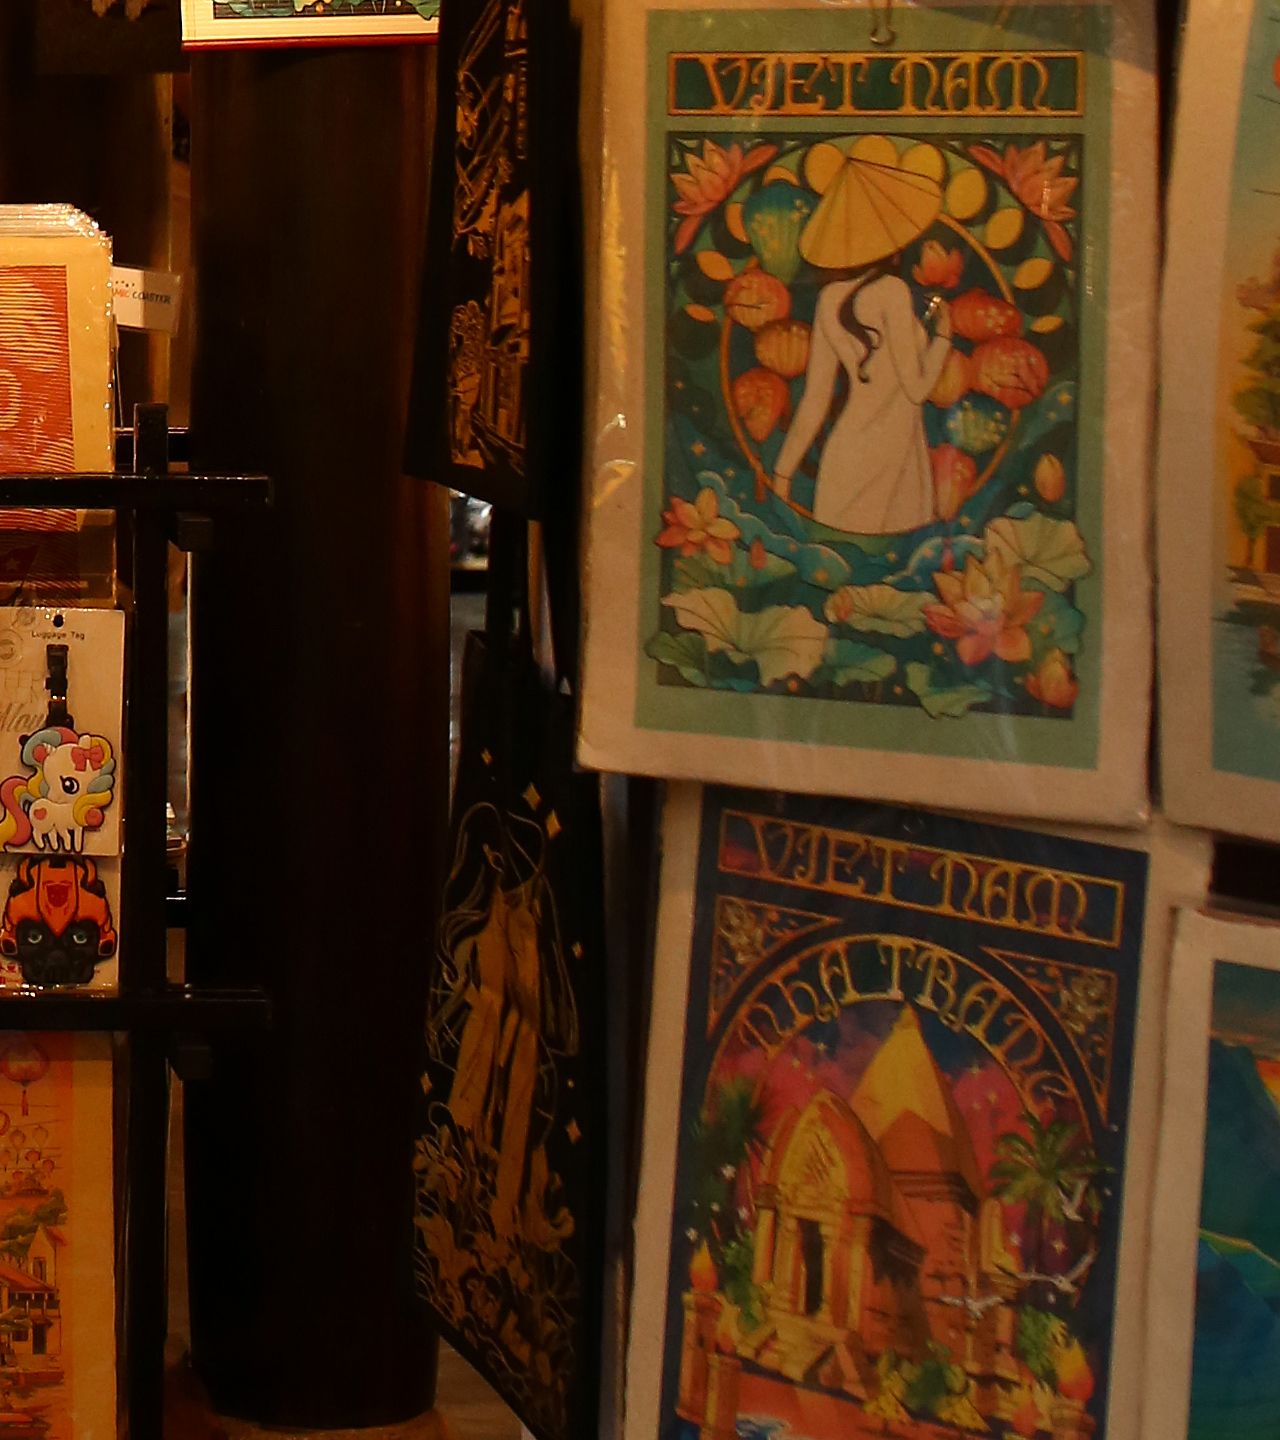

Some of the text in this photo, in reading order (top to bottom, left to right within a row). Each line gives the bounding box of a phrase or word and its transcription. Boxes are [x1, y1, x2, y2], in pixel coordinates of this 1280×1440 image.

[697, 54, 1053, 114] VIET NAM
[31, 630, 86, 642] Luggage Tag
[747, 817, 1087, 939] VIET NAM
[738, 934, 1076, 1117] NHA TRANG
